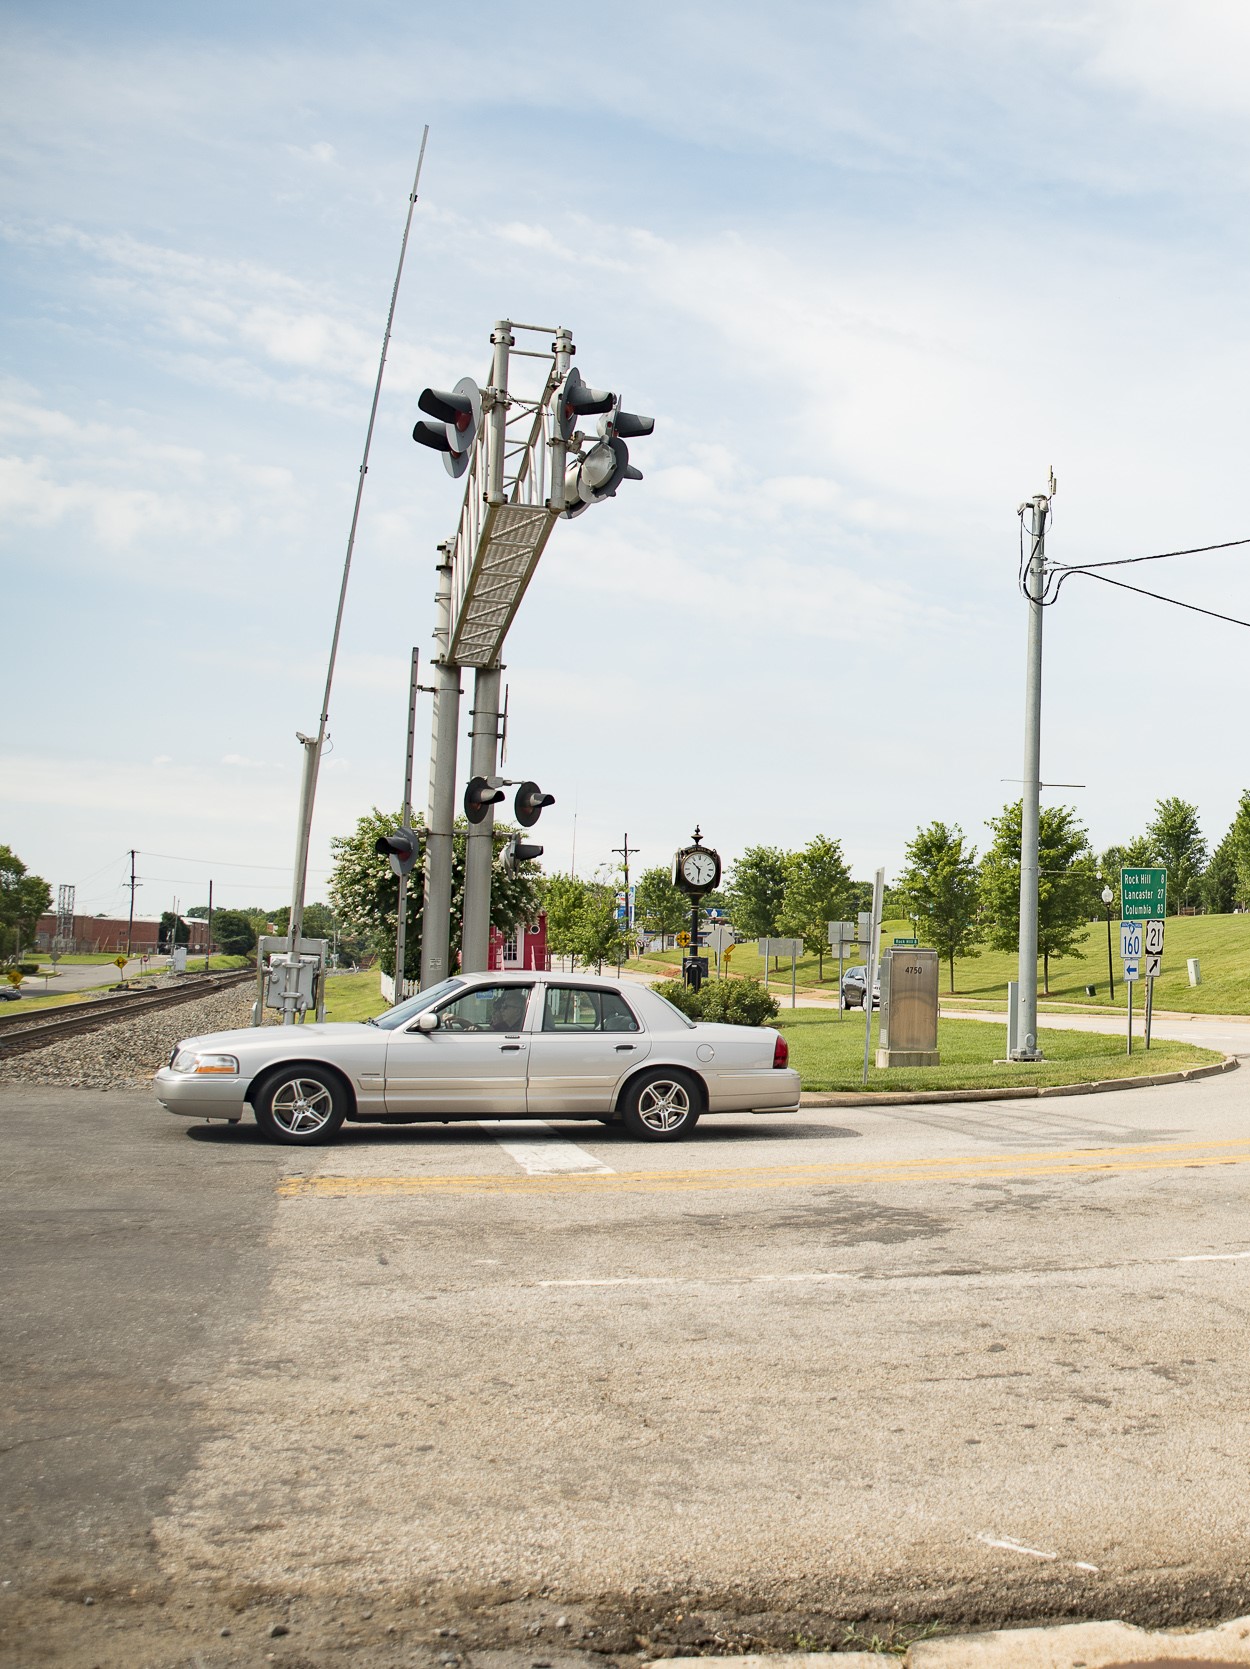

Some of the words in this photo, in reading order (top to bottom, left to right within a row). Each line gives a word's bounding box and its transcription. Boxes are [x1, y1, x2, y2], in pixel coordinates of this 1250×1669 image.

[1124, 874, 1139, 884] Rock
[1140, 874, 1151, 884] Hill
[1161, 874, 1165, 884] 8
[1124, 889, 1153, 900] Lancaster
[1157, 888, 1164, 899] 27
[1125, 905, 1152, 915] Columbia
[1157, 903, 1164, 914] 83
[1150, 928, 1160, 946] 21
[1124, 936, 1140, 954] 160
[905, 966, 923, 975] 4750
